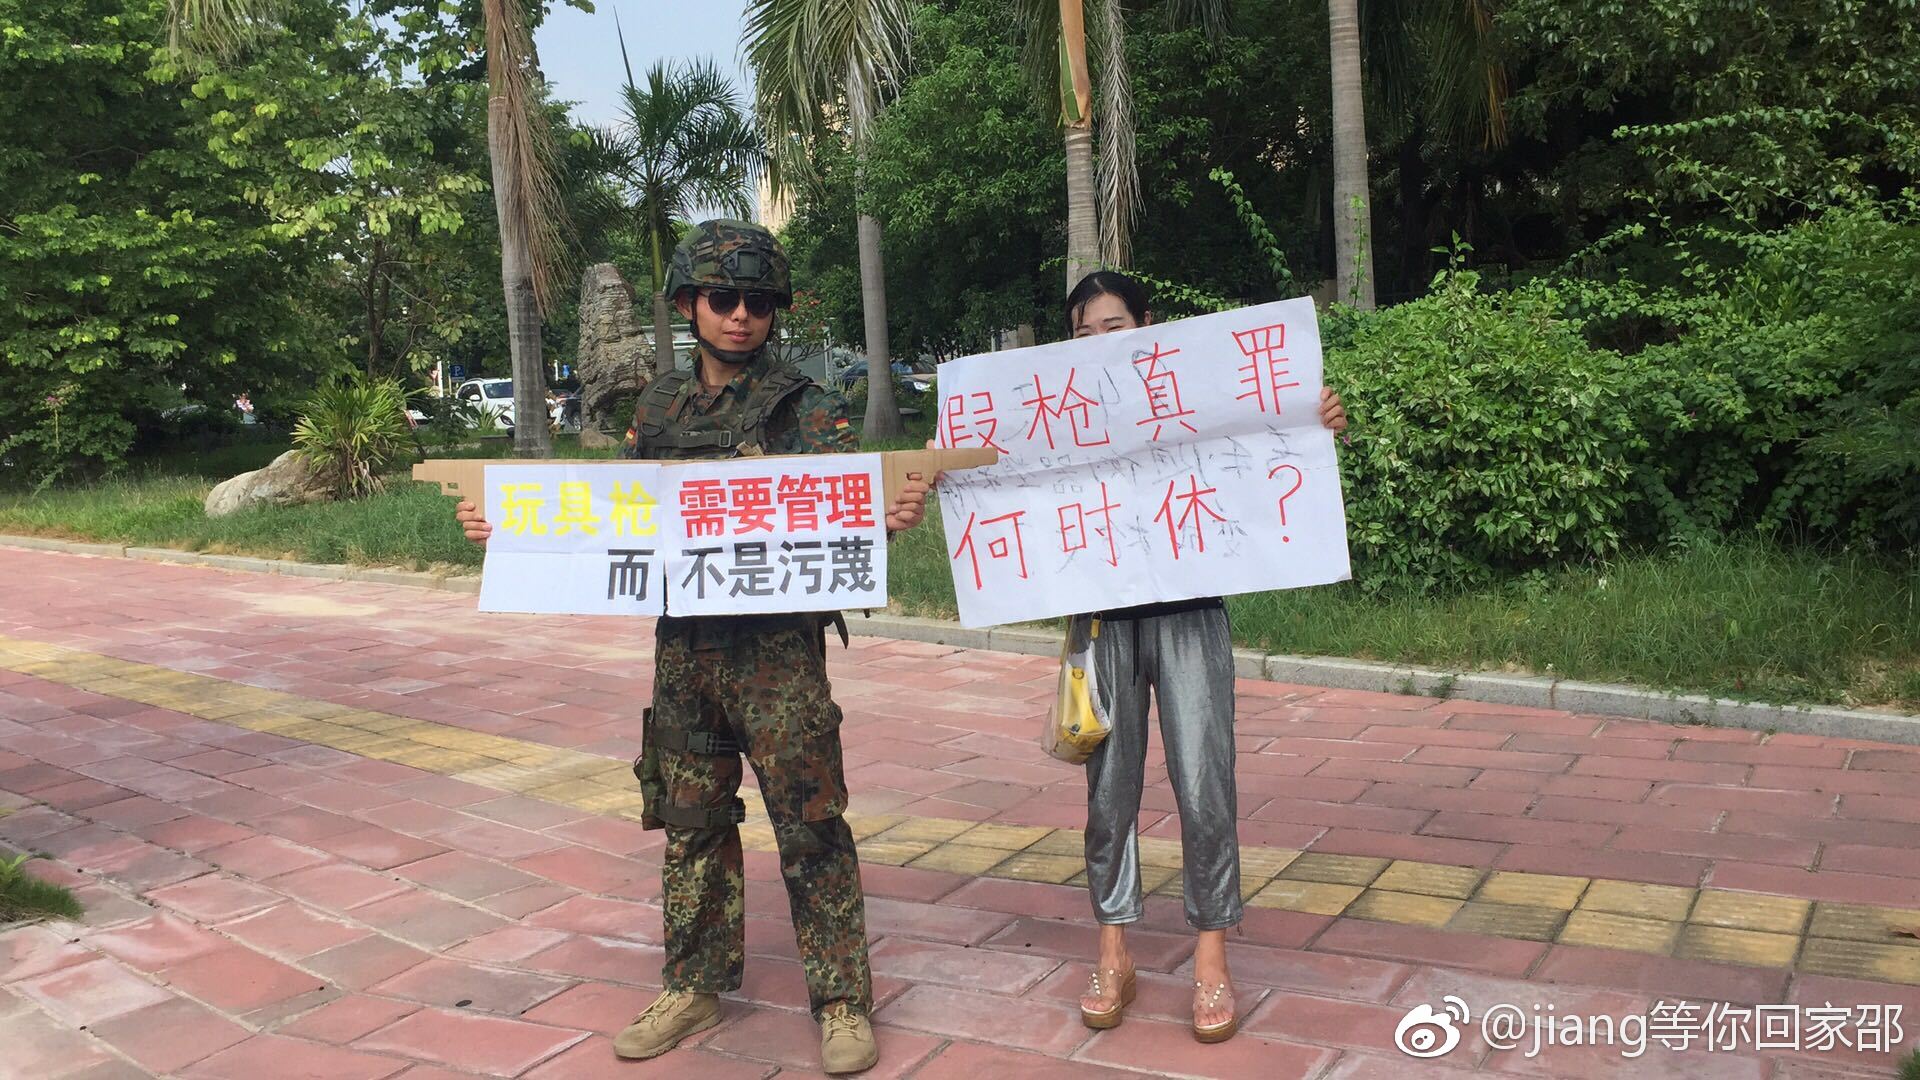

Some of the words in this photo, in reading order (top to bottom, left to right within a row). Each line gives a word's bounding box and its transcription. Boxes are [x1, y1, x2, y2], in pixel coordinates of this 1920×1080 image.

[940, 322, 1300, 455] 假枪真罪
[499, 480, 658, 537] 玩具枪
[678, 473, 876, 538] 需要管理
[953, 464, 1303, 591] 何时休？
[607, 548, 656, 601] 而
[681, 535, 877, 600] 不是污蔑
